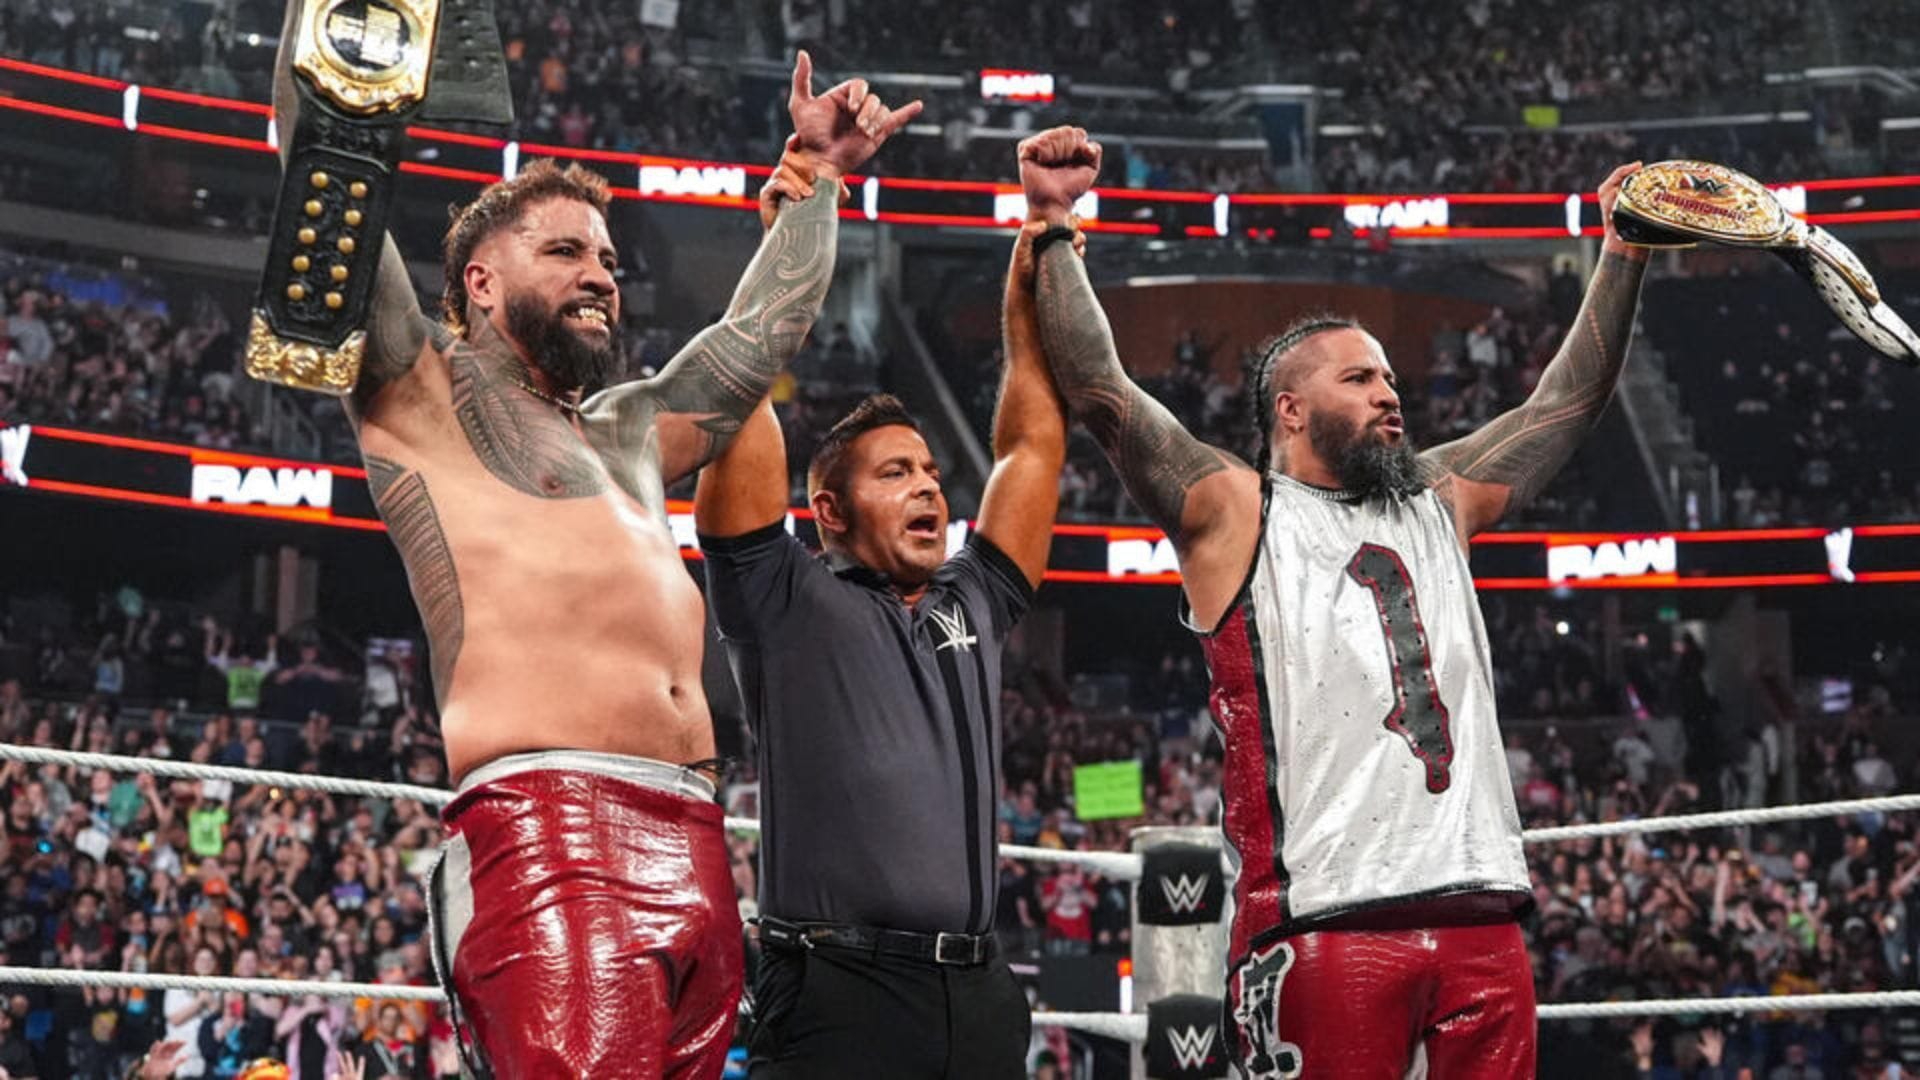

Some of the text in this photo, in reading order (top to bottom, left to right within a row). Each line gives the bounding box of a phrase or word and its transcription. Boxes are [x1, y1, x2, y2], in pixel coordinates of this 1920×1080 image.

[639, 165, 746, 196] RAW
[192, 464, 332, 507] RAW
[1107, 538, 1181, 577] RA
[1548, 537, 1677, 582] RAW
